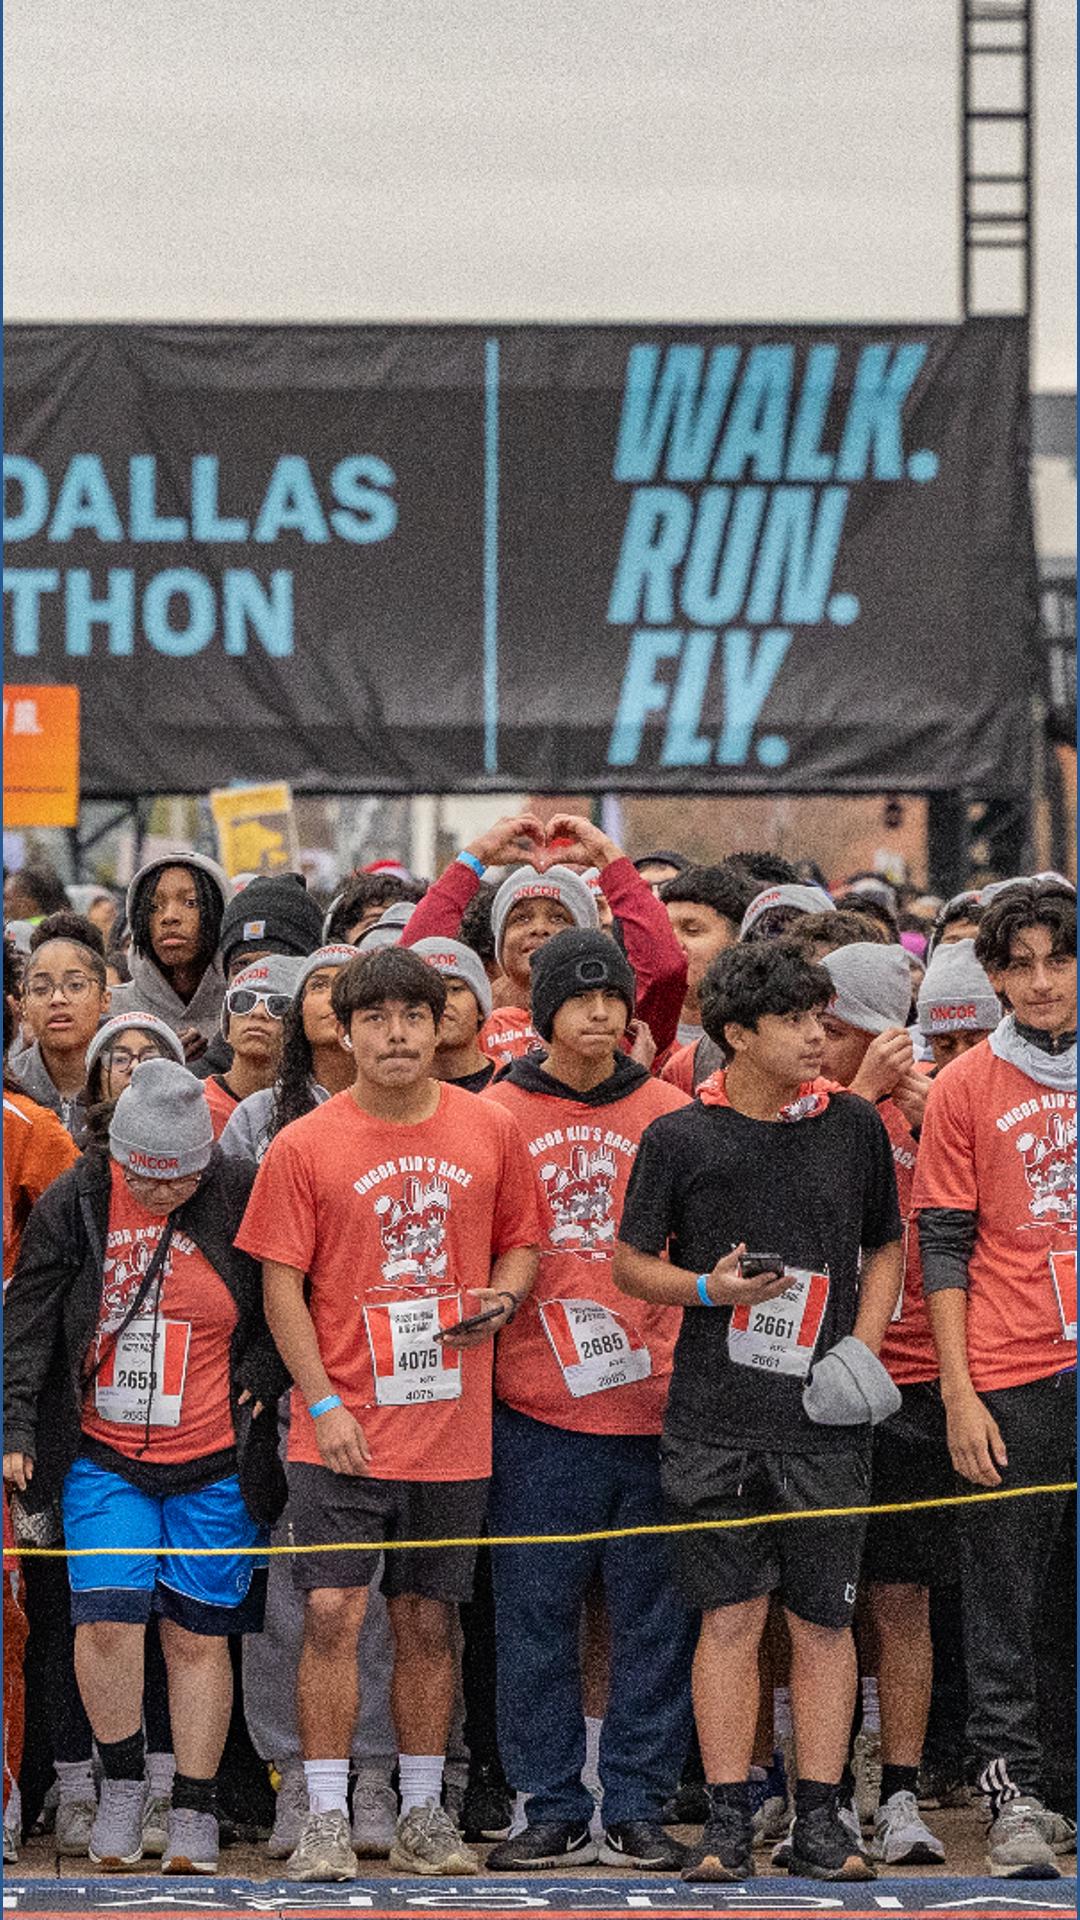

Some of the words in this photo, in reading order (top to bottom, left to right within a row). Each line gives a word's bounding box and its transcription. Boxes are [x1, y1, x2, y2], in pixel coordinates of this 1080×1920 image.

[612, 343, 940, 483] WALK.
[3, 453, 400, 544] DALLAS
[606, 486, 861, 627] RUN.
[3, 567, 296, 657] THON
[606, 627, 795, 768] FLY.
[928, 1004, 977, 1020] ONCOR
[995, 1098, 1040, 1132] ONCOR
[527, 1129, 564, 1157] NCOR
[566, 1125, 602, 1142] KID'S
[129, 1151, 179, 1169] ONCOR
[353, 1161, 398, 1195] ONCOR
[399, 1156, 436, 1173] KID'S
[438, 1161, 473, 1188] RACE
[108, 1229, 132, 1248] COR
[753, 1313, 795, 1339] 2661
[398, 1349, 438, 1371] 4075
[581, 1332, 624, 1359] 2685
[405, 1389, 434, 1401] 4075
